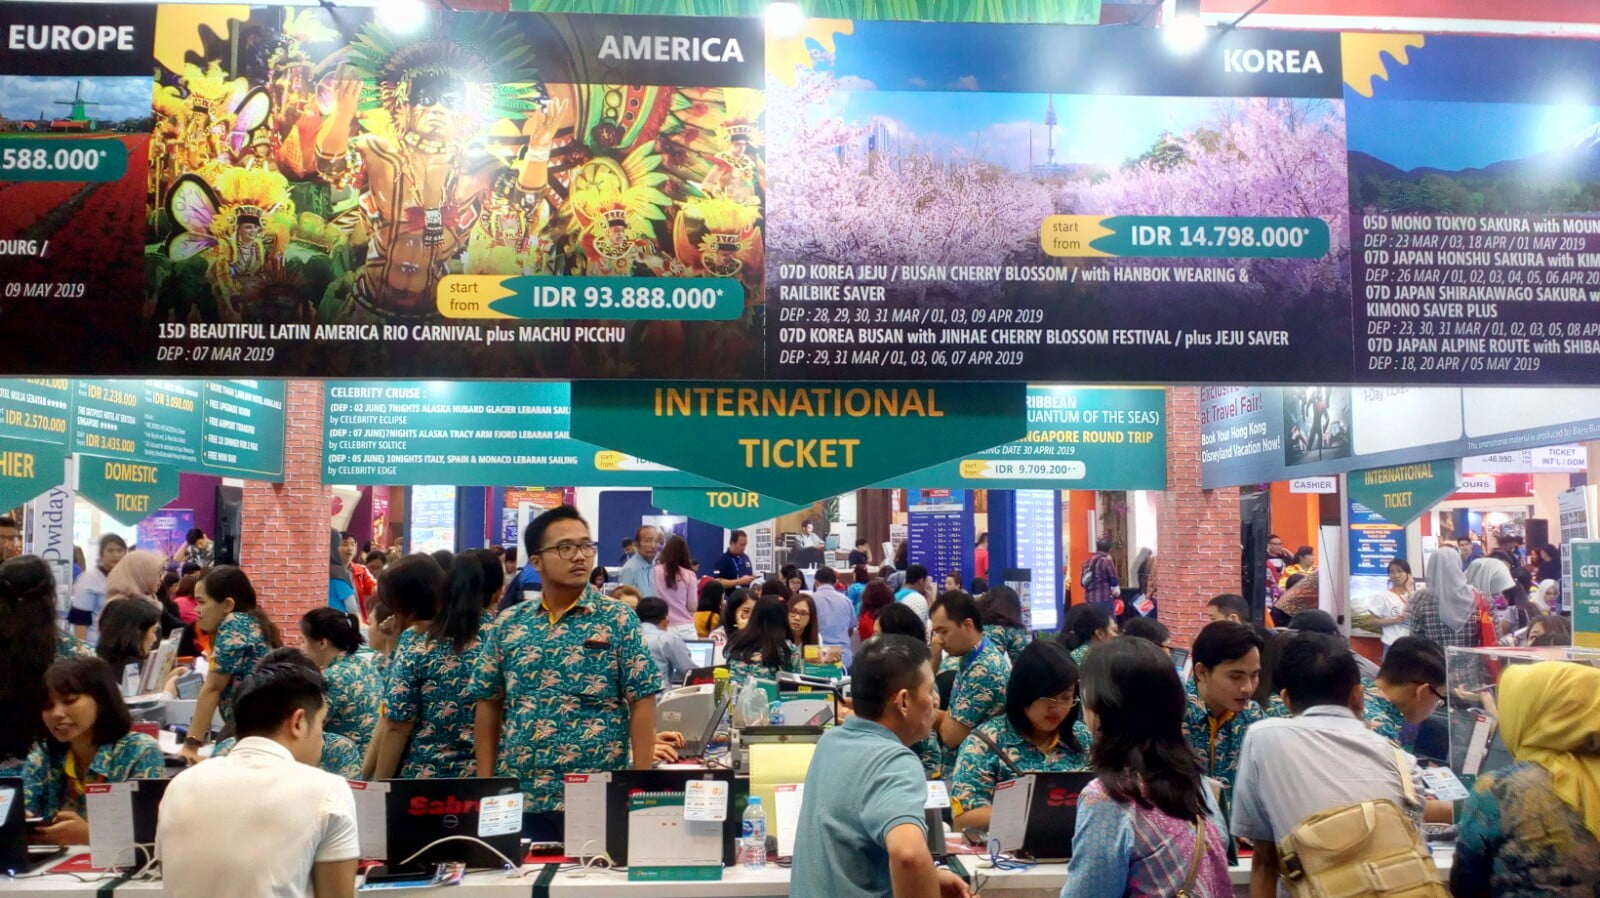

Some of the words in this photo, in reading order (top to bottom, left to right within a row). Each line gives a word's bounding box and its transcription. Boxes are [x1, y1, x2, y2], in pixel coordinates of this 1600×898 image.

[8, 25, 134, 50] EUROPE
[598, 35, 744, 63] AMERICA
[1223, 50, 1323, 75] KOREA
[1053, 222, 1079, 233] start
[1363, 216, 1388, 230] 05D
[1391, 216, 1432, 231] MONO
[1435, 216, 1476, 231] TOKYO
[1480, 217, 1530, 233] SAKURA
[1533, 218, 1560, 233] with
[1053, 238, 1081, 250] from
[1131, 225, 1172, 246] IDR
[1364, 250, 1389, 265] 07D
[1393, 251, 1434, 266] JAPAN
[1438, 251, 1491, 266] HONSHU
[1494, 252, 1544, 267] SAKURA
[1547, 252, 1574, 267] with
[780, 264, 806, 280] 07D
[810, 264, 854, 280] KOREA
[858, 264, 887, 280] JEJU
[902, 265, 946, 281] BUSAN
[950, 265, 1001, 281] CHERRY
[1005, 265, 1067, 281] BLOSSOM
[1081, 266, 1110, 282] with
[1113, 267, 1171, 282] HANBOK
[1174, 267, 1236, 283] WEARING
[1238, 268, 1249, 283] &
[5, 282, 21, 297] 09
[23, 283, 53, 297] MAY
[54, 283, 85, 298] 2019
[450, 281, 478, 294] start
[780, 285, 840, 301] RAILBIKE
[843, 285, 886, 301] SAVER
[1366, 285, 1391, 300] 07D
[1394, 285, 1435, 300] JAPAN
[1439, 286, 1533, 301] SHIRAKAWAGO
[1536, 287, 1587, 302] SAKURA
[450, 298, 479, 312] from
[533, 286, 577, 308] IDR
[1367, 303, 1420, 318] KIMONO
[1423, 303, 1463, 318] SAVER
[1467, 303, 1498, 318] PLUS
[158, 323, 186, 339] 15D
[190, 323, 266, 340] BEAUTIFUL
[270, 324, 311, 340] LATIN
[314, 324, 379, 341] AMERICA
[383, 325, 408, 341] RIO
[412, 325, 483, 342] CARNIVAL
[487, 325, 515, 346] plus
[519, 326, 571, 342] MACHU
[575, 327, 626, 343] PICCHU
[780, 328, 806, 343] 07D
[810, 328, 854, 344] KOREA
[858, 328, 903, 344] BUSAN
[907, 328, 936, 344] with
[939, 329, 988, 344] JINHAE
[991, 329, 1042, 344] CHERRY
[1046, 329, 1109, 345] BLOSSOM
[1112, 330, 1172, 345] FESTIVAL
[1185, 330, 1212, 349] plus
[1215, 330, 1244, 346] JEJU
[1248, 330, 1289, 346] SAVER
[157, 346, 183, 361] DEP
[192, 347, 209, 361] 07
[211, 347, 241, 361] MAR
[244, 347, 275, 362] 2019
[1368, 338, 1392, 352] 07D
[1396, 338, 1437, 353] JAPAN
[1441, 338, 1485, 353] ALPINE
[1489, 339, 1530, 353] ROUTE
[1533, 339, 1561, 354] with
[88, 384, 101, 399] IDR
[331, 387, 382, 398] CELEBRITY
[385, 387, 420, 399] CRUISE
[654, 388, 944, 417] INTERNATIONAL
[1201, 409, 1210, 425] at
[1212, 398, 1238, 422] Travel
[1240, 392, 1263, 415] Fair!
[6, 409, 22, 426] IDR
[330, 416, 339, 425] by
[340, 416, 378, 424] CELEBRITY
[379, 416, 408, 425] ECLIPSE
[1083, 411, 1100, 423] OF
[1102, 411, 1125, 424] THE
[1128, 411, 1160, 426] SEAS)
[86, 433, 100, 447] IDR
[1015, 430, 1079, 444] NGAPORE
[1083, 431, 1125, 444] ROUND
[1128, 431, 1154, 444] TRIP
[1202, 432, 1216, 446] Book
[1217, 430, 1230, 443] Your
[1231, 426, 1248, 439] Hong
[1249, 422, 1267, 436] Kong
[329, 441, 338, 451] by
[339, 441, 377, 449] CELEBRITY
[378, 441, 407, 450] SOLTICE
[738, 439, 860, 468] TICKET
[1002, 446, 1022, 455] DATE
[1022, 446, 1033, 455] 30
[1034, 446, 1055, 455] APRIL
[1056, 446, 1075, 455] 2019
[1202, 446, 1233, 463] Disneyland
[1233, 441, 1262, 457] Vacation
[1262, 435, 1281, 452] Now!
[363, 455, 385, 464] JUNE)
[387, 455, 423, 464] 10NIGHTS
[447, 455, 469, 464] SPAIN
[478, 455, 511, 464] MONACO
[513, 456, 547, 464] LEBARAN
[548, 456, 578, 465] SAILING
[104, 462, 158, 484] DOMESTIC
[328, 466, 337, 476] by
[338, 466, 376, 475] CELEBRITY
[377, 466, 397, 475] EDGE
[995, 465, 1013, 474] IDR
[1364, 464, 1433, 486] INTERNATIONAL
[1294, 481, 1332, 489] CASHIER
[115, 493, 150, 512] TICKET
[706, 491, 759, 508] TOUR
[1384, 492, 1413, 509] TICKET
[408, 796, 480, 816] Sabr
